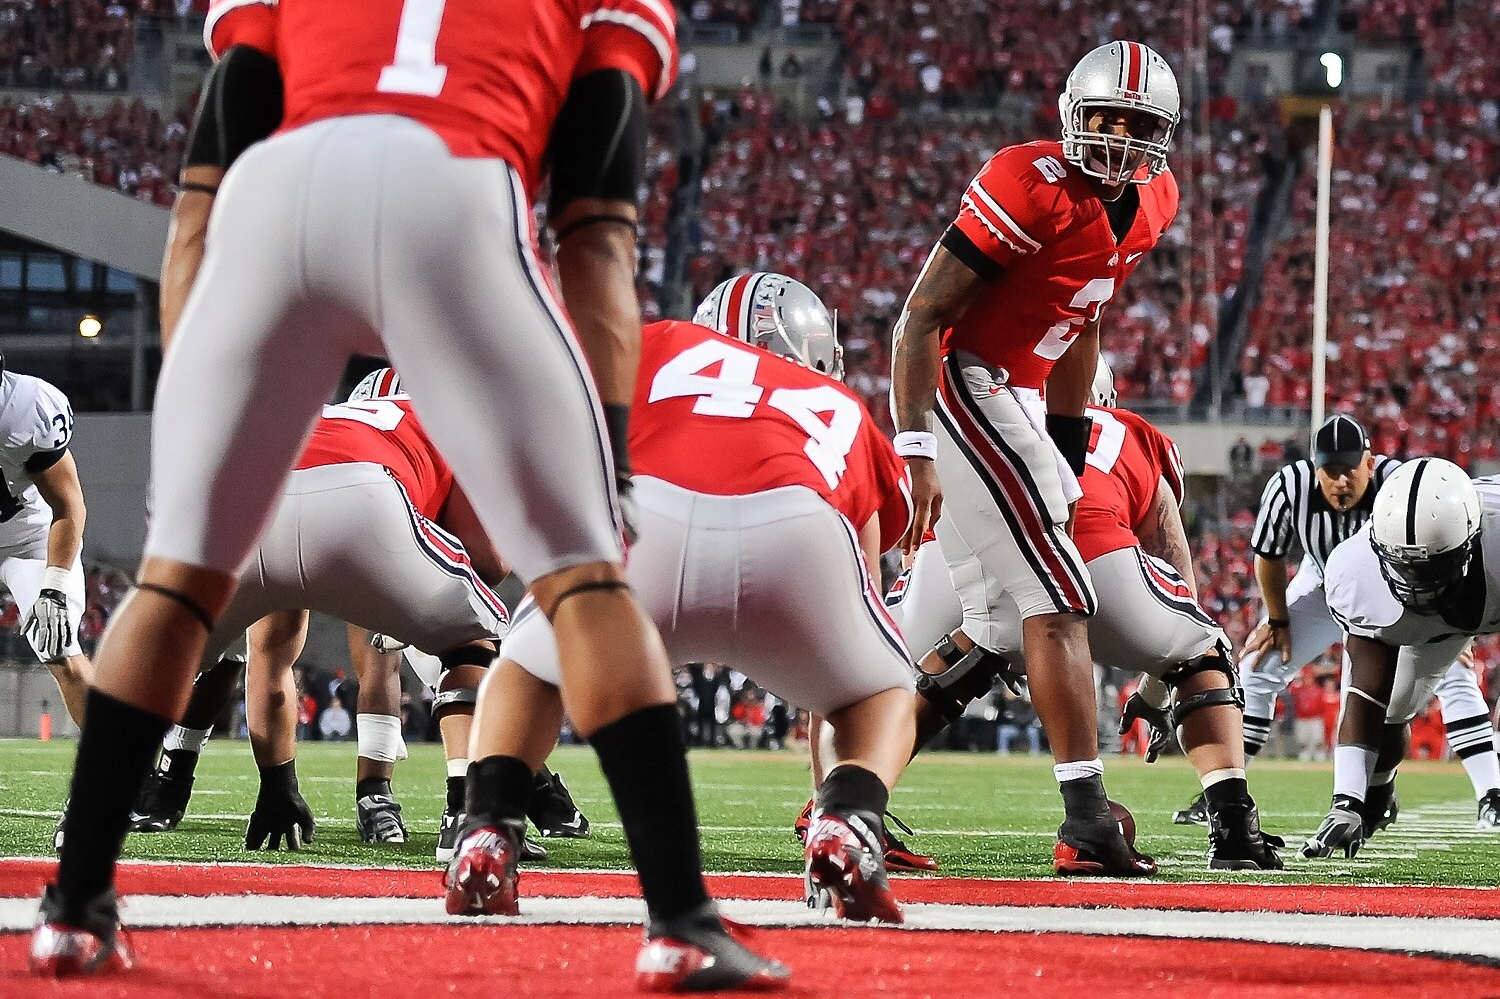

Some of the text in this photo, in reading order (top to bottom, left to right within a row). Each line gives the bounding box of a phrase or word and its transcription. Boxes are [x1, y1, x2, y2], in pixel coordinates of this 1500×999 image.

[1032, 156, 1067, 183] 2
[1033, 278, 1115, 360] 2
[648, 339, 862, 491] 44
